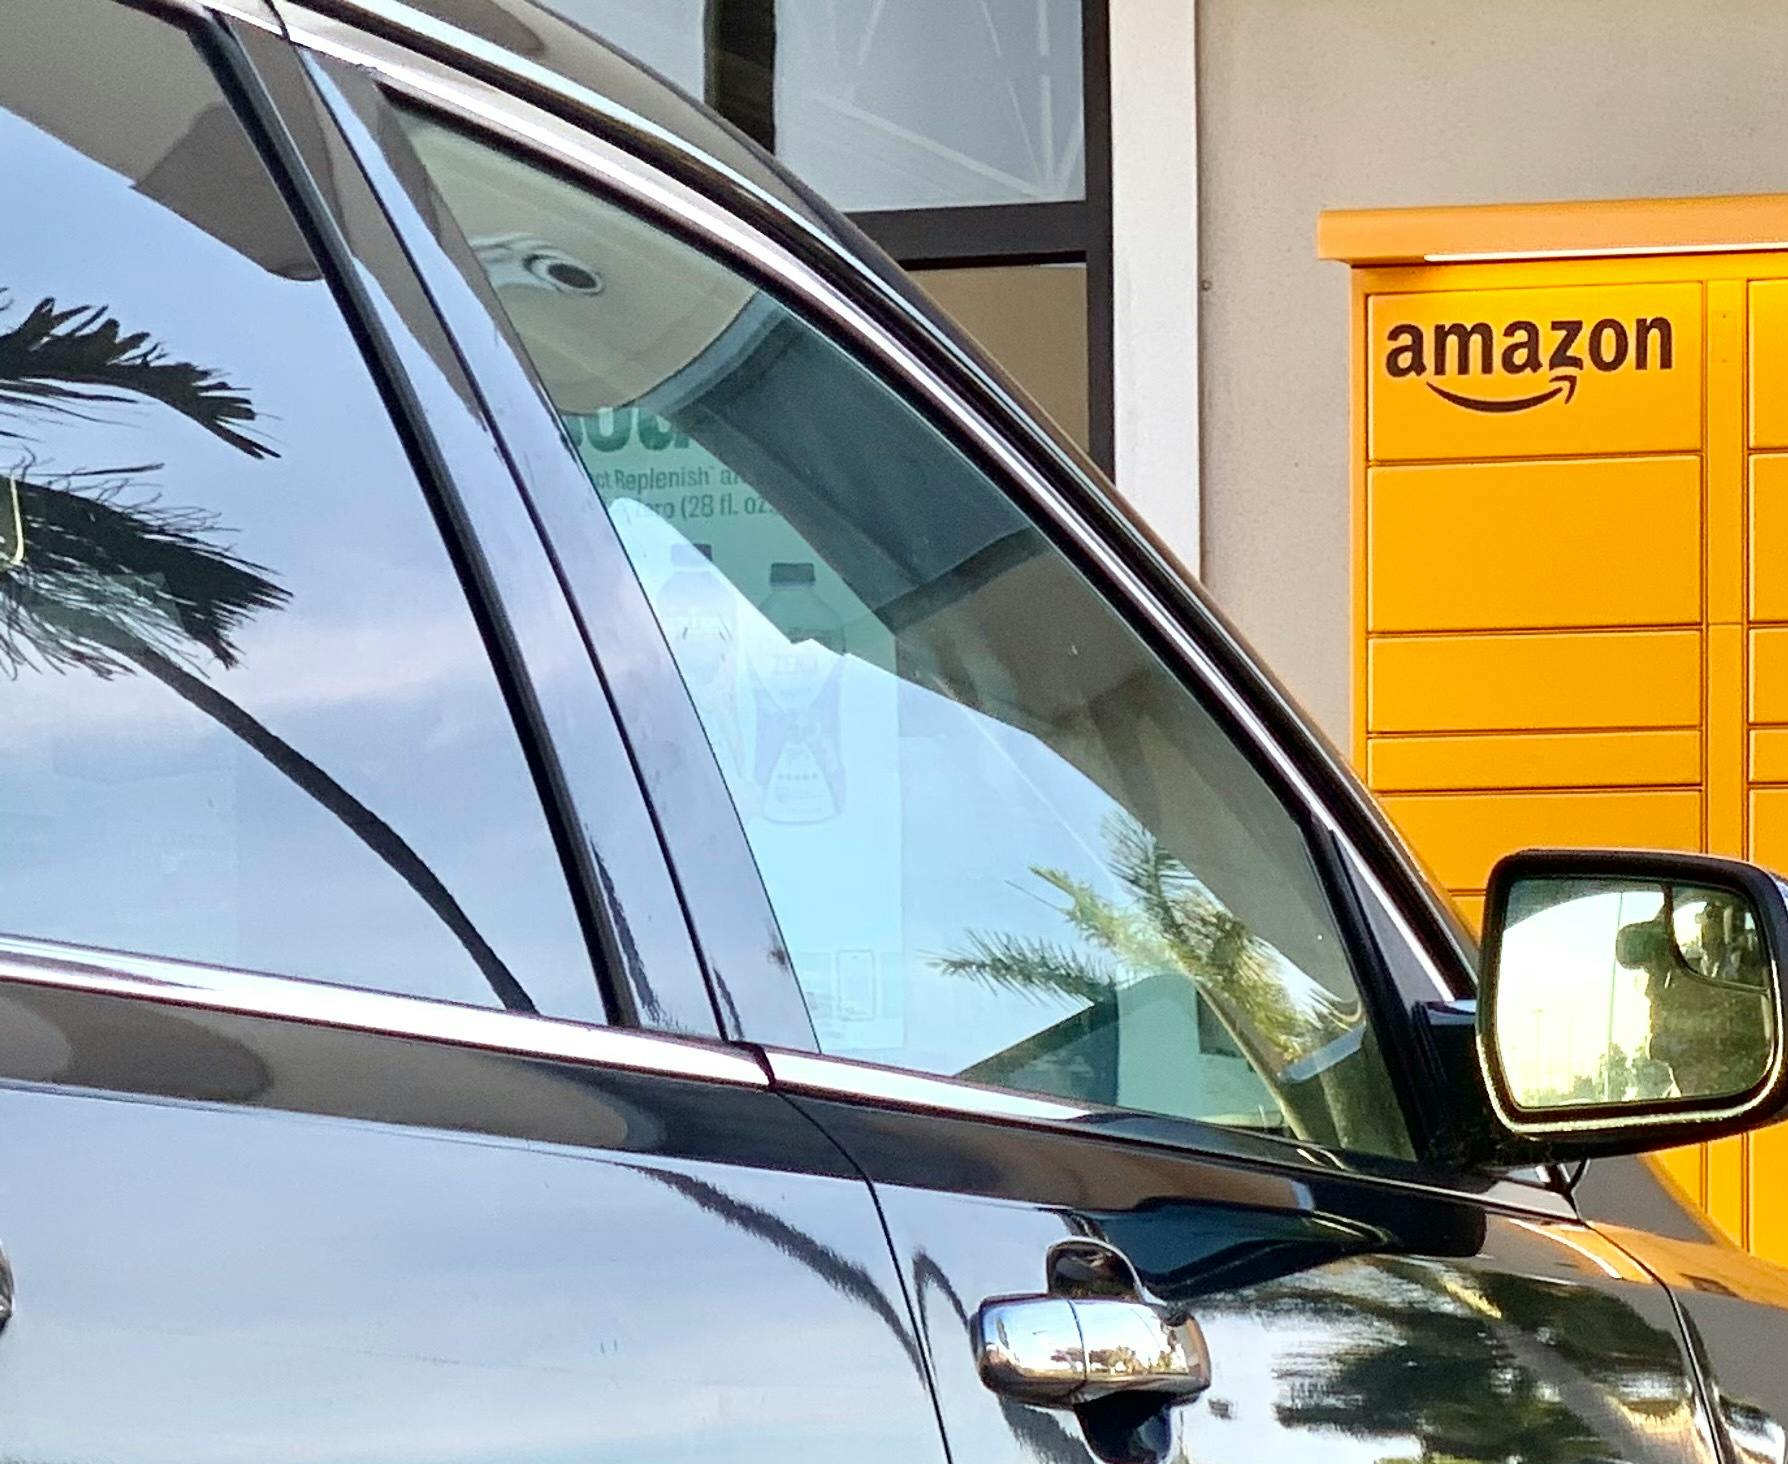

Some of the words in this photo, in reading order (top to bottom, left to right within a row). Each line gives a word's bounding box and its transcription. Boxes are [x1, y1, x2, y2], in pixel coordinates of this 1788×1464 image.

[1385, 316, 1673, 378] amazon
[681, 493, 715, 521] (28
[720, 492, 739, 517] fl.
